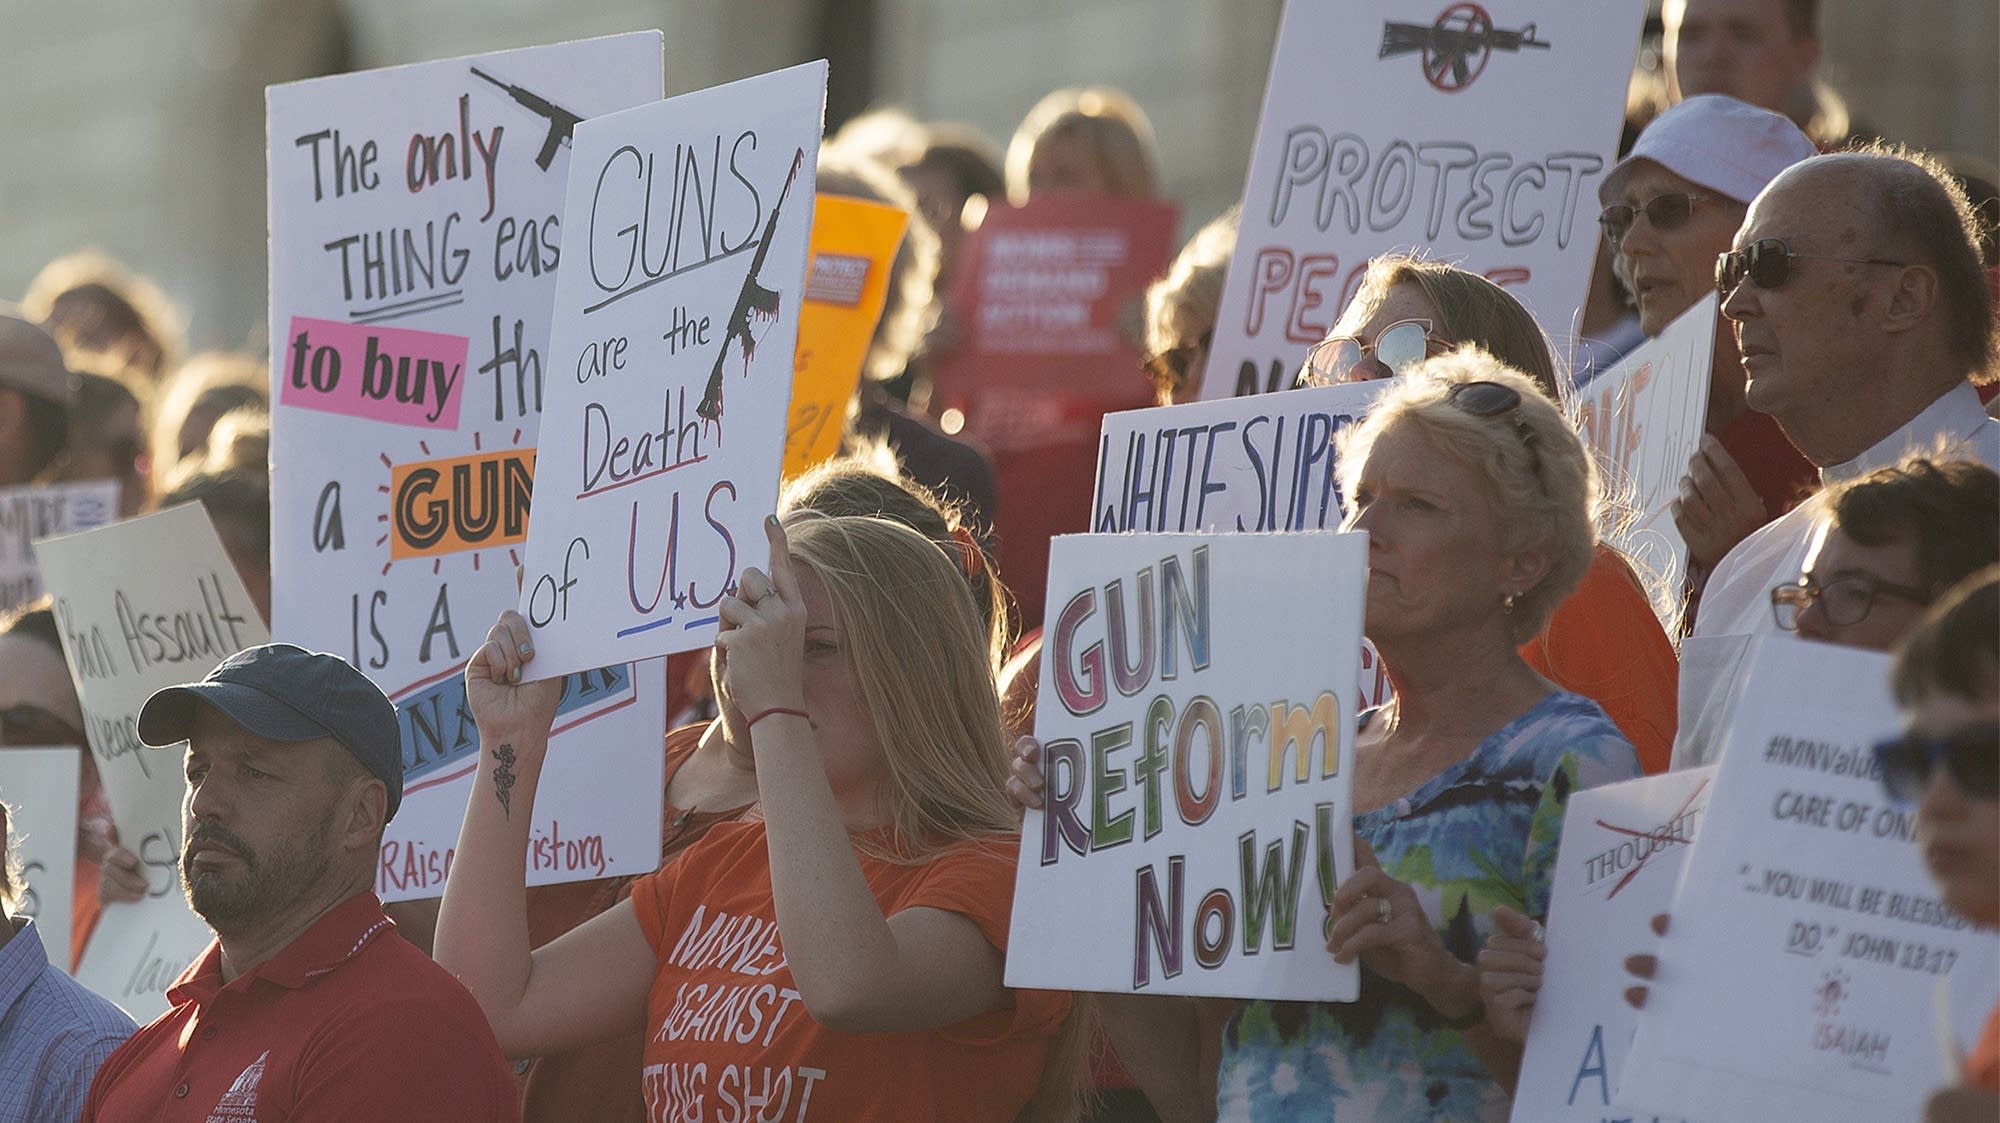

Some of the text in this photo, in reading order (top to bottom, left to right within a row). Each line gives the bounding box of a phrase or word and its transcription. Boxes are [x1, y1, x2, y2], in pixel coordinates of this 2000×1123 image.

[295, 94, 504, 223] The only
[1269, 124, 1602, 250] PROTECT
[590, 130, 761, 292] GUNS
[325, 212, 559, 302] THING eas
[291, 315, 541, 422] to buy th
[577, 307, 711, 384] are the
[583, 386, 701, 493] Death
[1095, 422, 1236, 533] WHITE
[313, 455, 536, 553] a GUN
[114, 570, 246, 674] Assault
[352, 584, 460, 670] IS A
[529, 537, 589, 628] of
[1052, 544, 1211, 717] GUN
[1765, 736, 1883, 781] #MNValue
[1584, 807, 1704, 885] THOUGHT
[1773, 791, 1918, 842] CARE OF ON
[1809, 878, 1854, 910] WILL
[1857, 887, 1884, 915] BE
[1841, 932, 1899, 964] JOHN
[653, 982, 801, 1047] AGAINST
[716, 1064, 826, 1123] SHOT
